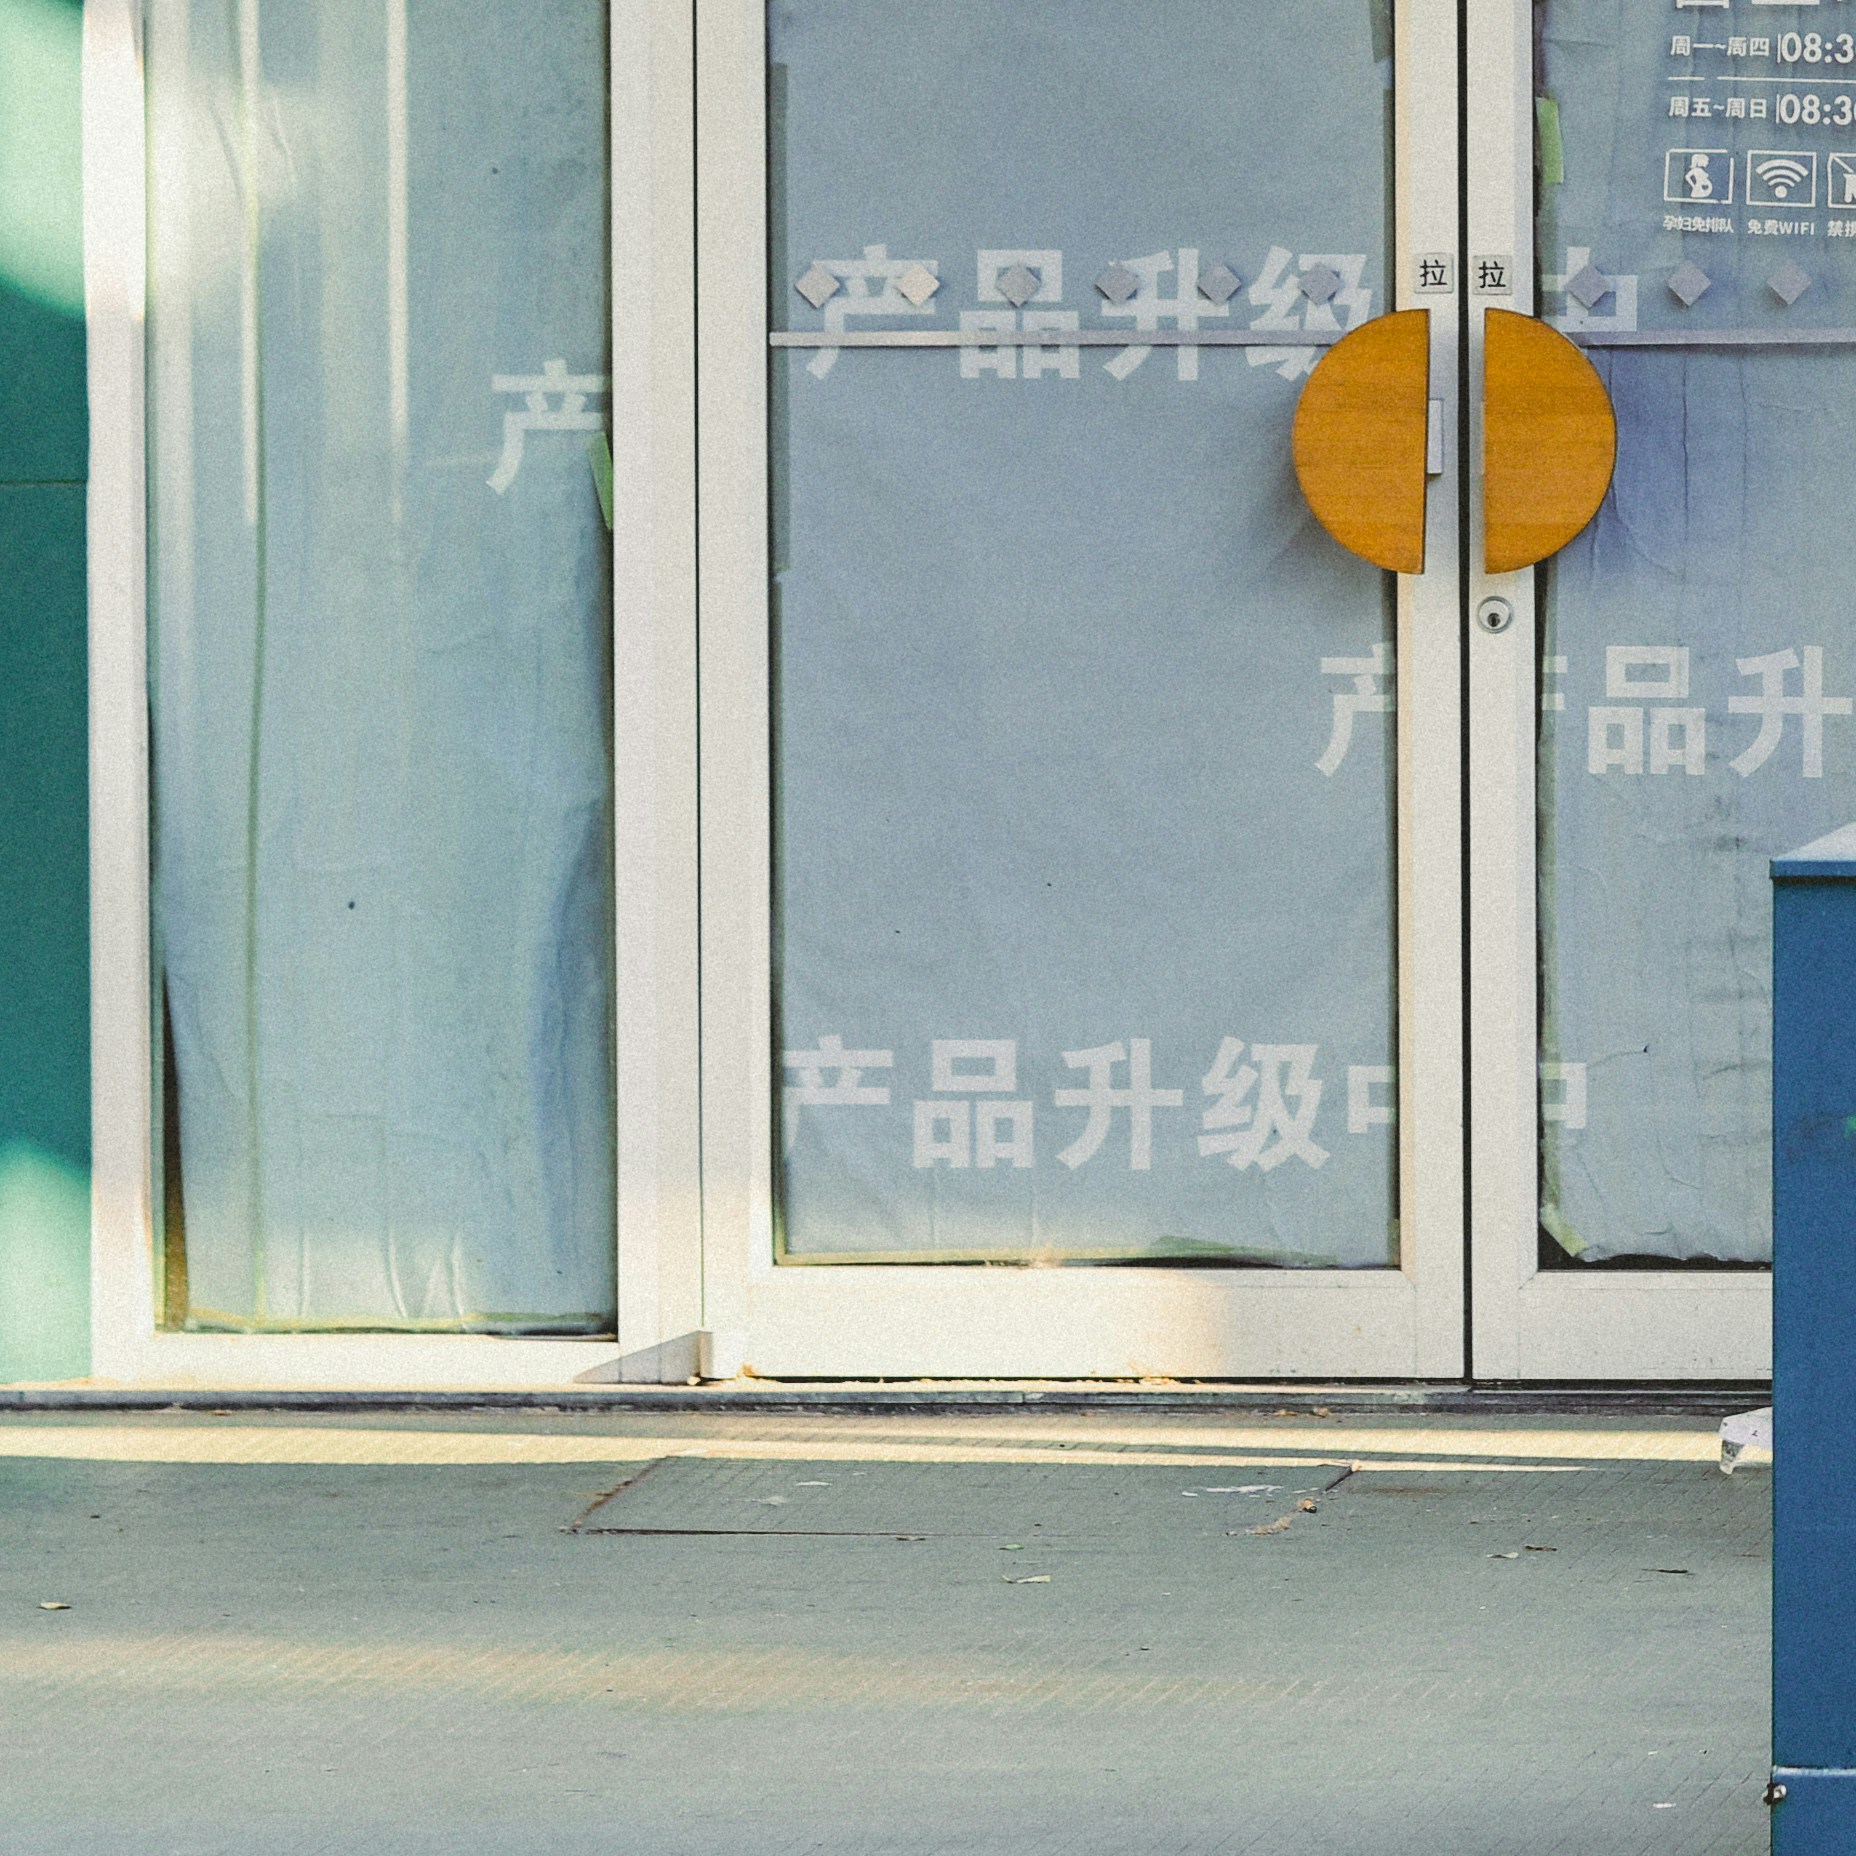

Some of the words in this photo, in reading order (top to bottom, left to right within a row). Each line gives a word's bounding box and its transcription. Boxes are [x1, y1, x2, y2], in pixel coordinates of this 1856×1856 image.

[1663, 215, 1735, 234] 孕妇免排队
[1747, 218, 1815, 236] 免费WIFI
[1420, 259, 1448, 287] 拉
[1478, 260, 1506, 289] 拉
[486, 360, 608, 495] 产
